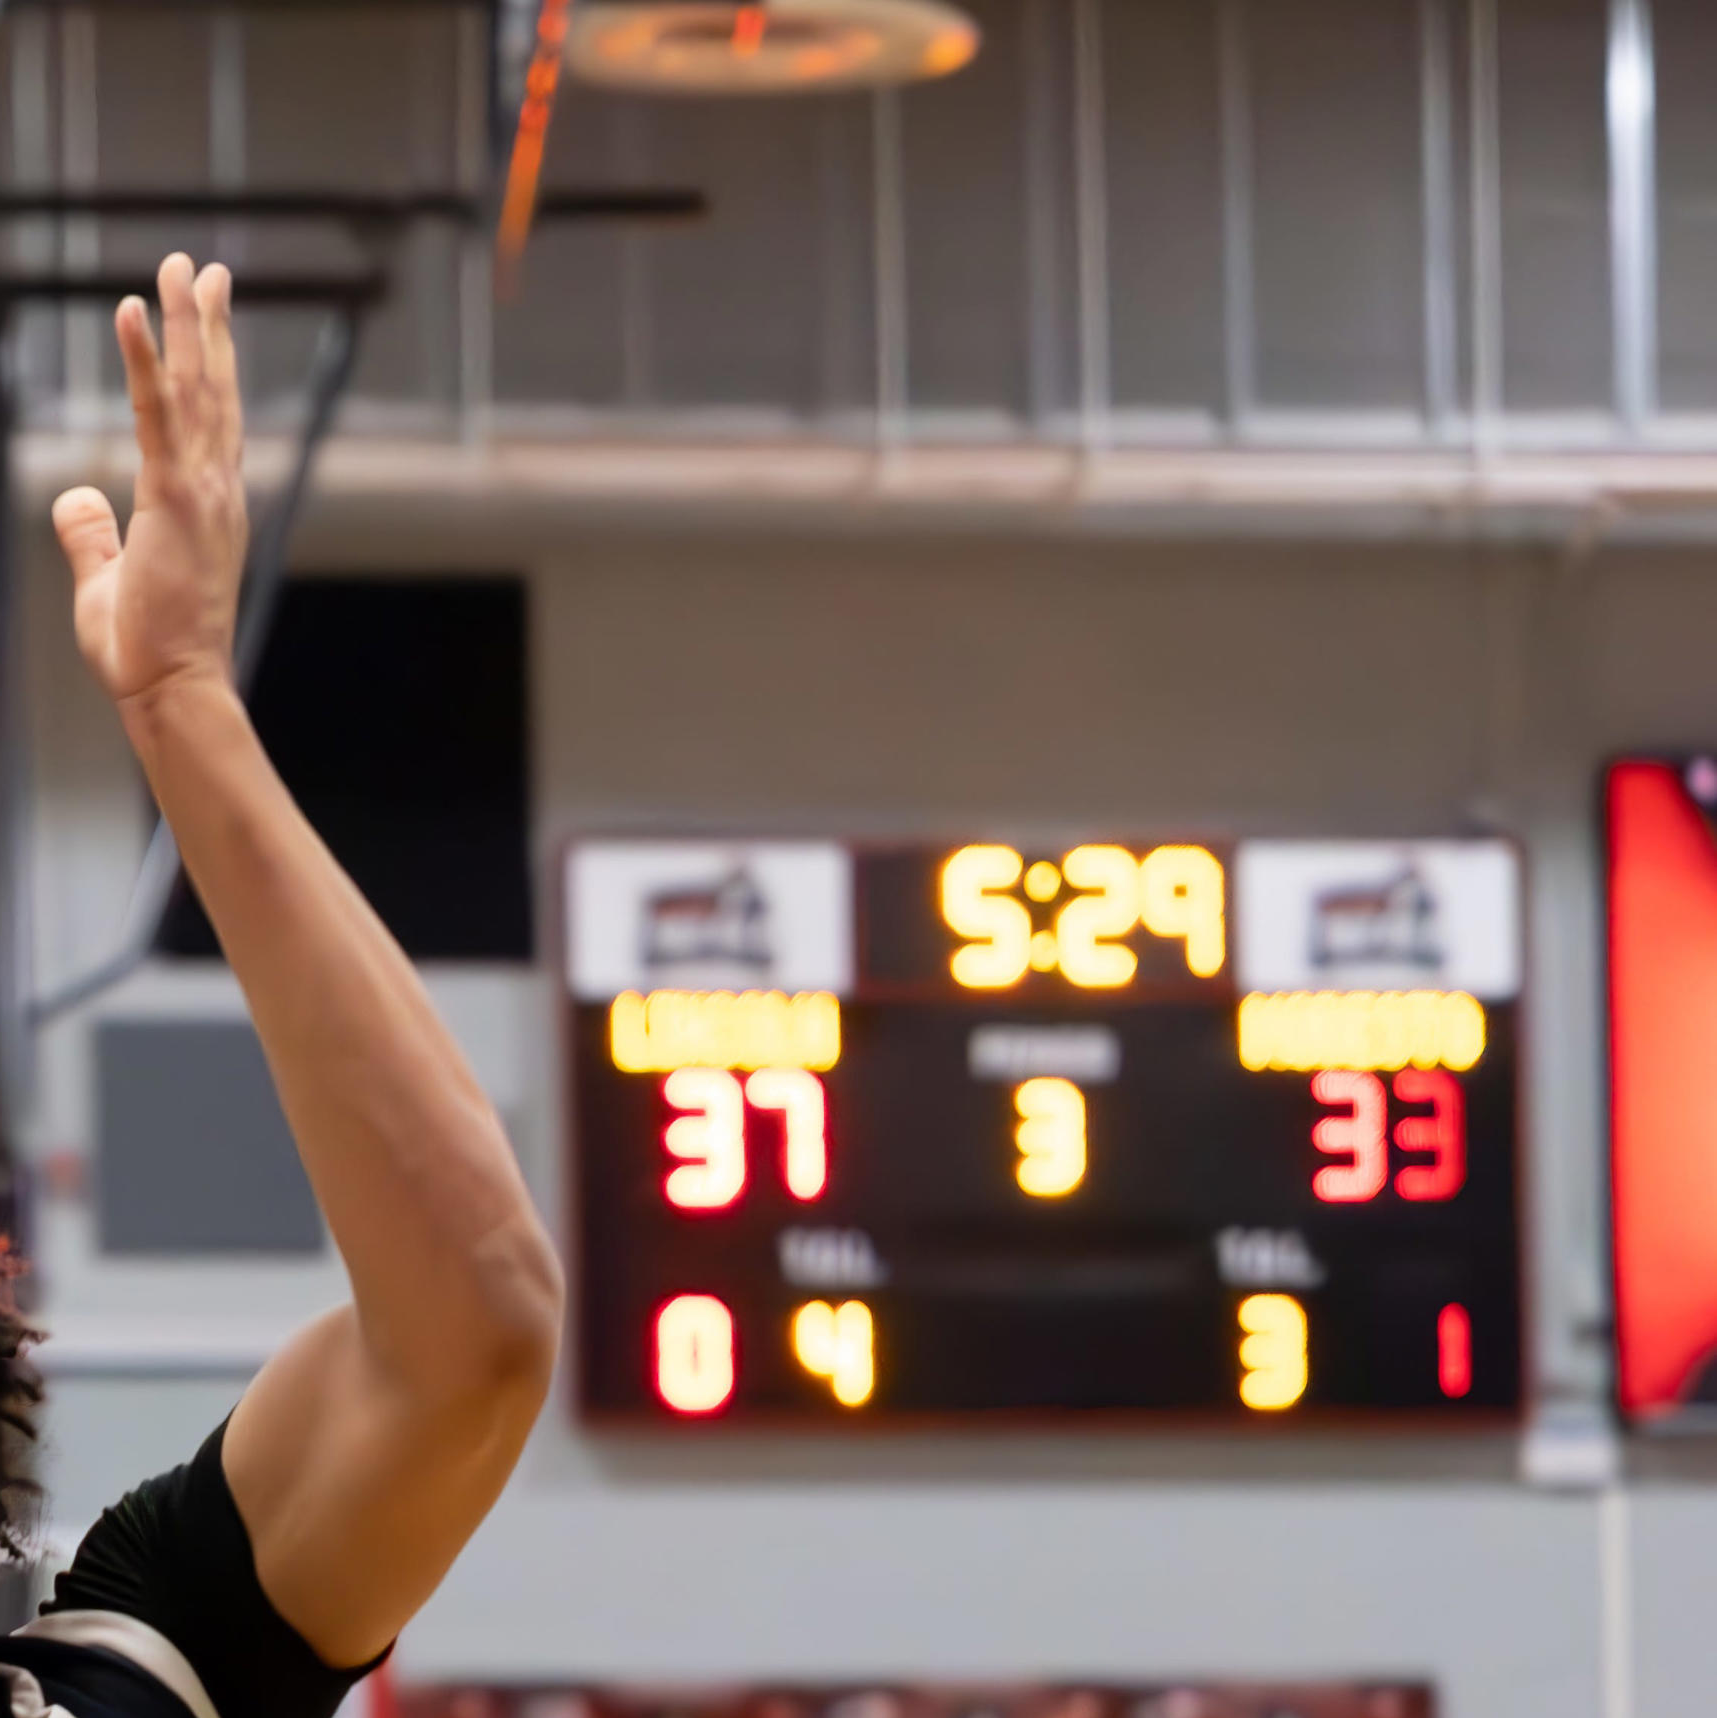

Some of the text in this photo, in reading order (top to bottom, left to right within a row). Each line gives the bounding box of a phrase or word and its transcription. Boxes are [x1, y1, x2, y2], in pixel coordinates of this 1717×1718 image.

[939, 843, 1225, 989] 5:29
[662, 1071, 831, 1208] 37
[1012, 1075, 1088, 1200] 3
[1310, 1074, 1464, 1203] 33
[650, 1293, 737, 1419] 0
[787, 1300, 877, 1410] 4
[1237, 1293, 1308, 1412] 3
[1438, 1304, 1470, 1396] 1
